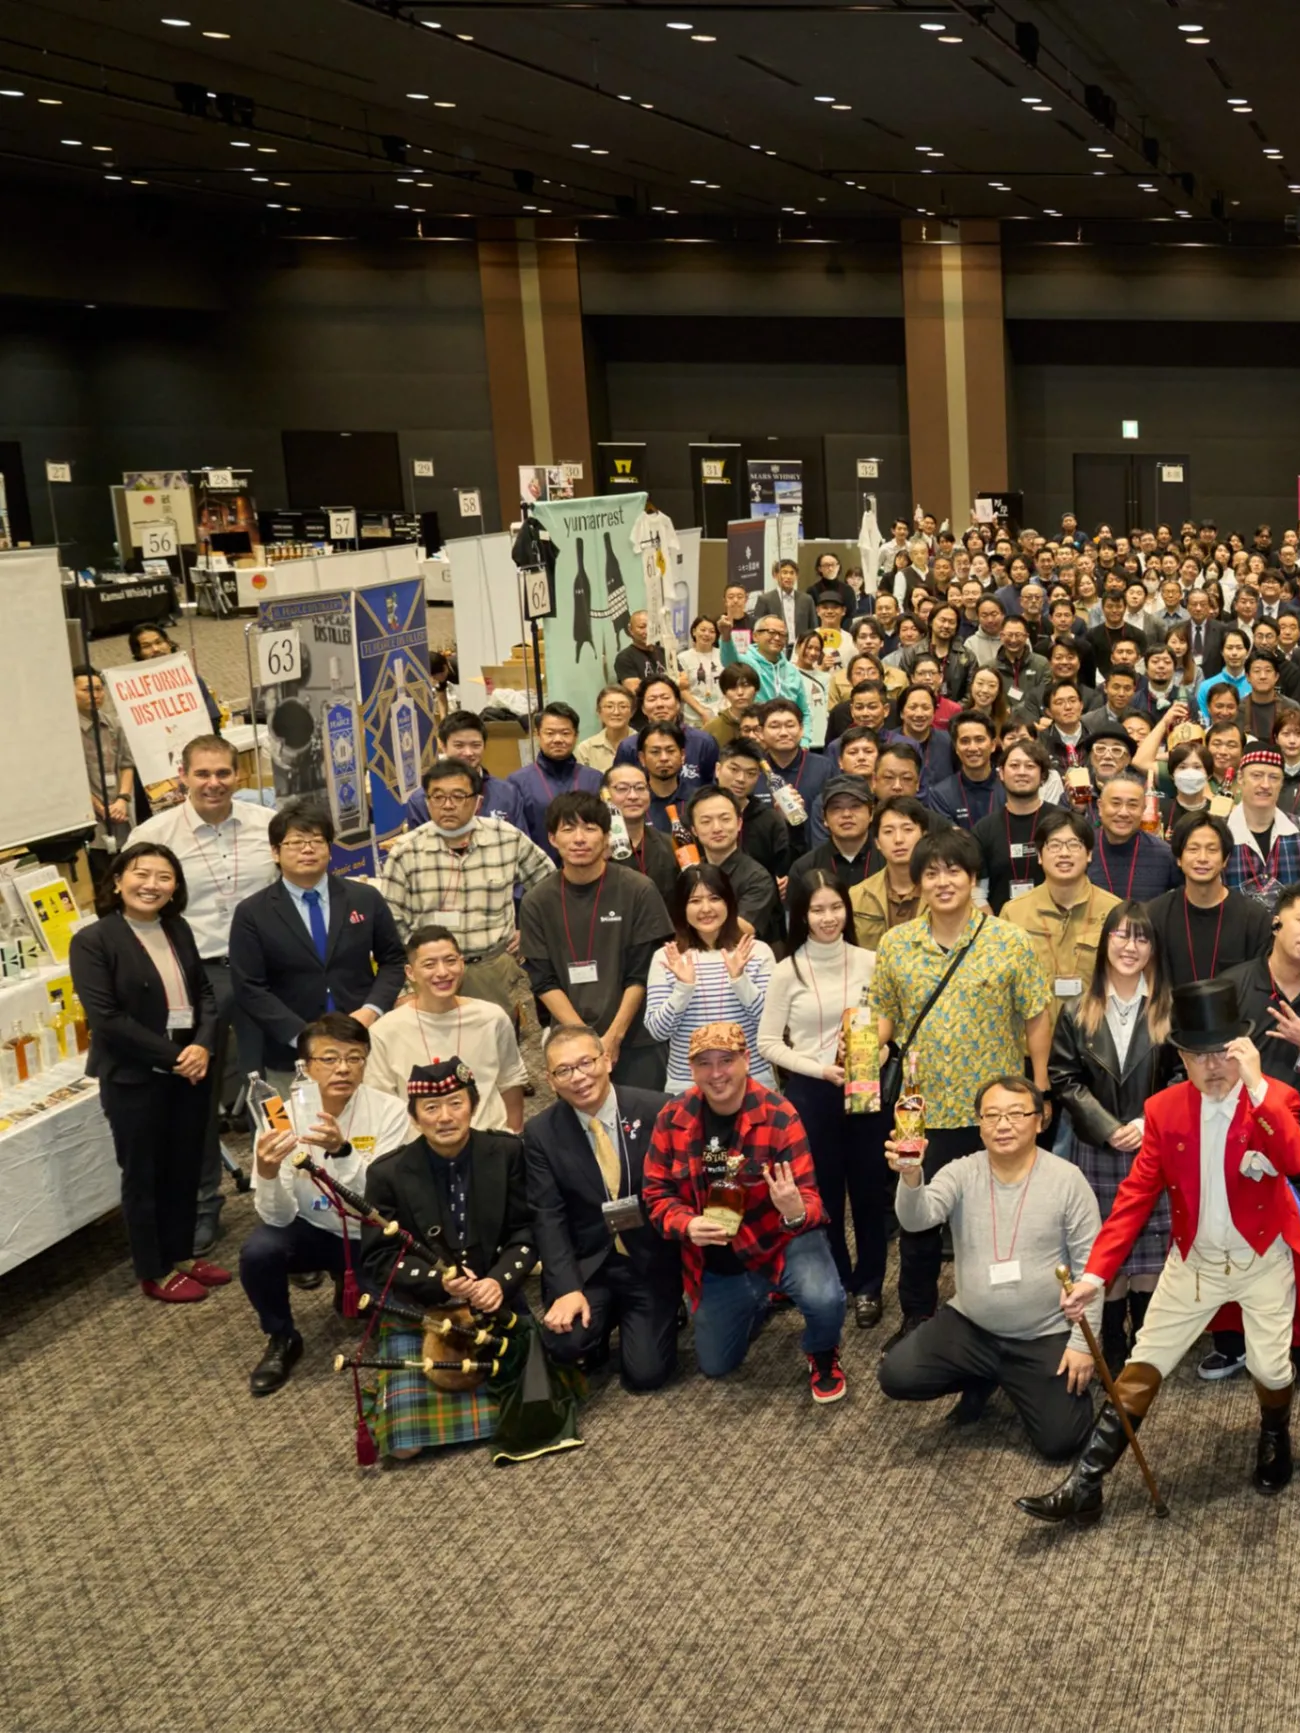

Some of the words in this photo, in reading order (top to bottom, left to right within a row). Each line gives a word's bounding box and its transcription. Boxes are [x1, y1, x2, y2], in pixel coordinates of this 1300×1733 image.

[50, 466, 66, 480] 27
[417, 463, 431, 474] 29
[565, 466, 579, 477] 30
[706, 464, 719, 476] 31
[861, 464, 875, 476] 32
[212, 474, 229, 486] 28
[750, 472, 771, 480] MARS
[772, 472, 800, 480] WHISKY
[463, 498, 477, 514] 58
[334, 518, 350, 536] 57
[149, 532, 172, 554] 56
[126, 587, 152, 599] Whisky
[532, 581, 547, 610] 62
[268, 638, 294, 675] 63
[115, 666, 194, 700] CALIFORNIA
[130, 692, 198, 726] DISTILLED
